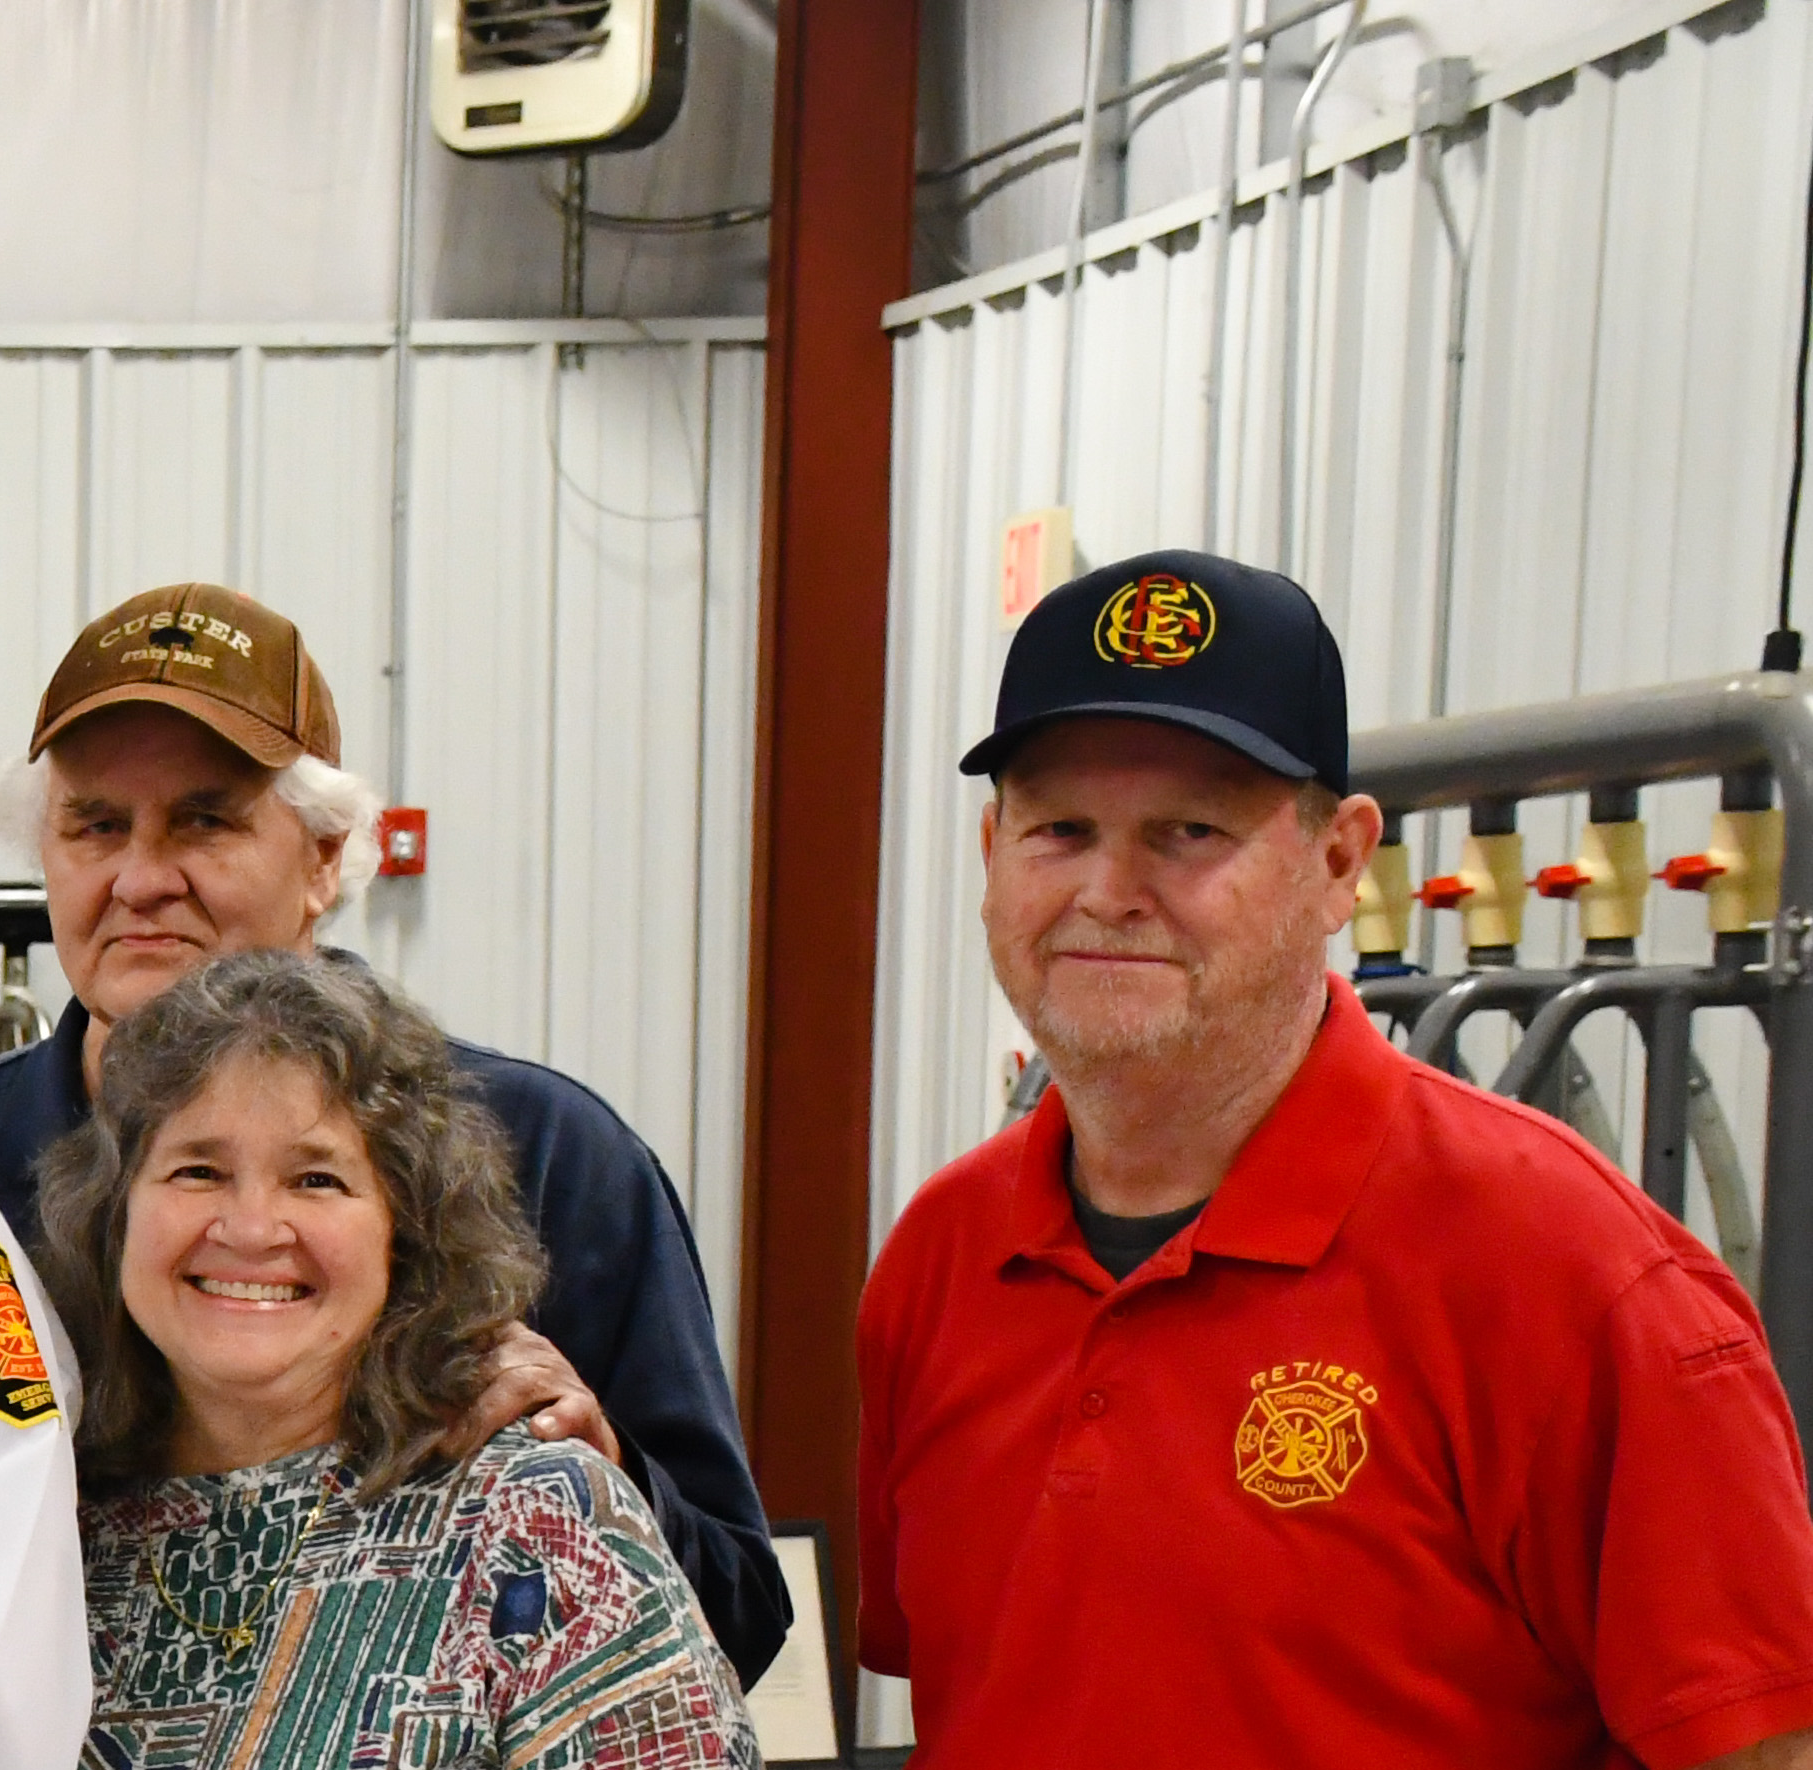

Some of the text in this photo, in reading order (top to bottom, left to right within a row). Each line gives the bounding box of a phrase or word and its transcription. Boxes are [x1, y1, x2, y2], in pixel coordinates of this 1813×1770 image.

[99, 611, 254, 658] CUSTER
[121, 647, 215, 670] STATE PARK
[1250, 1361, 1379, 1405] RETIRED
[1274, 1392, 1337, 1412] CHEROKEE
[1255, 1476, 1318, 1496] COUNTY
